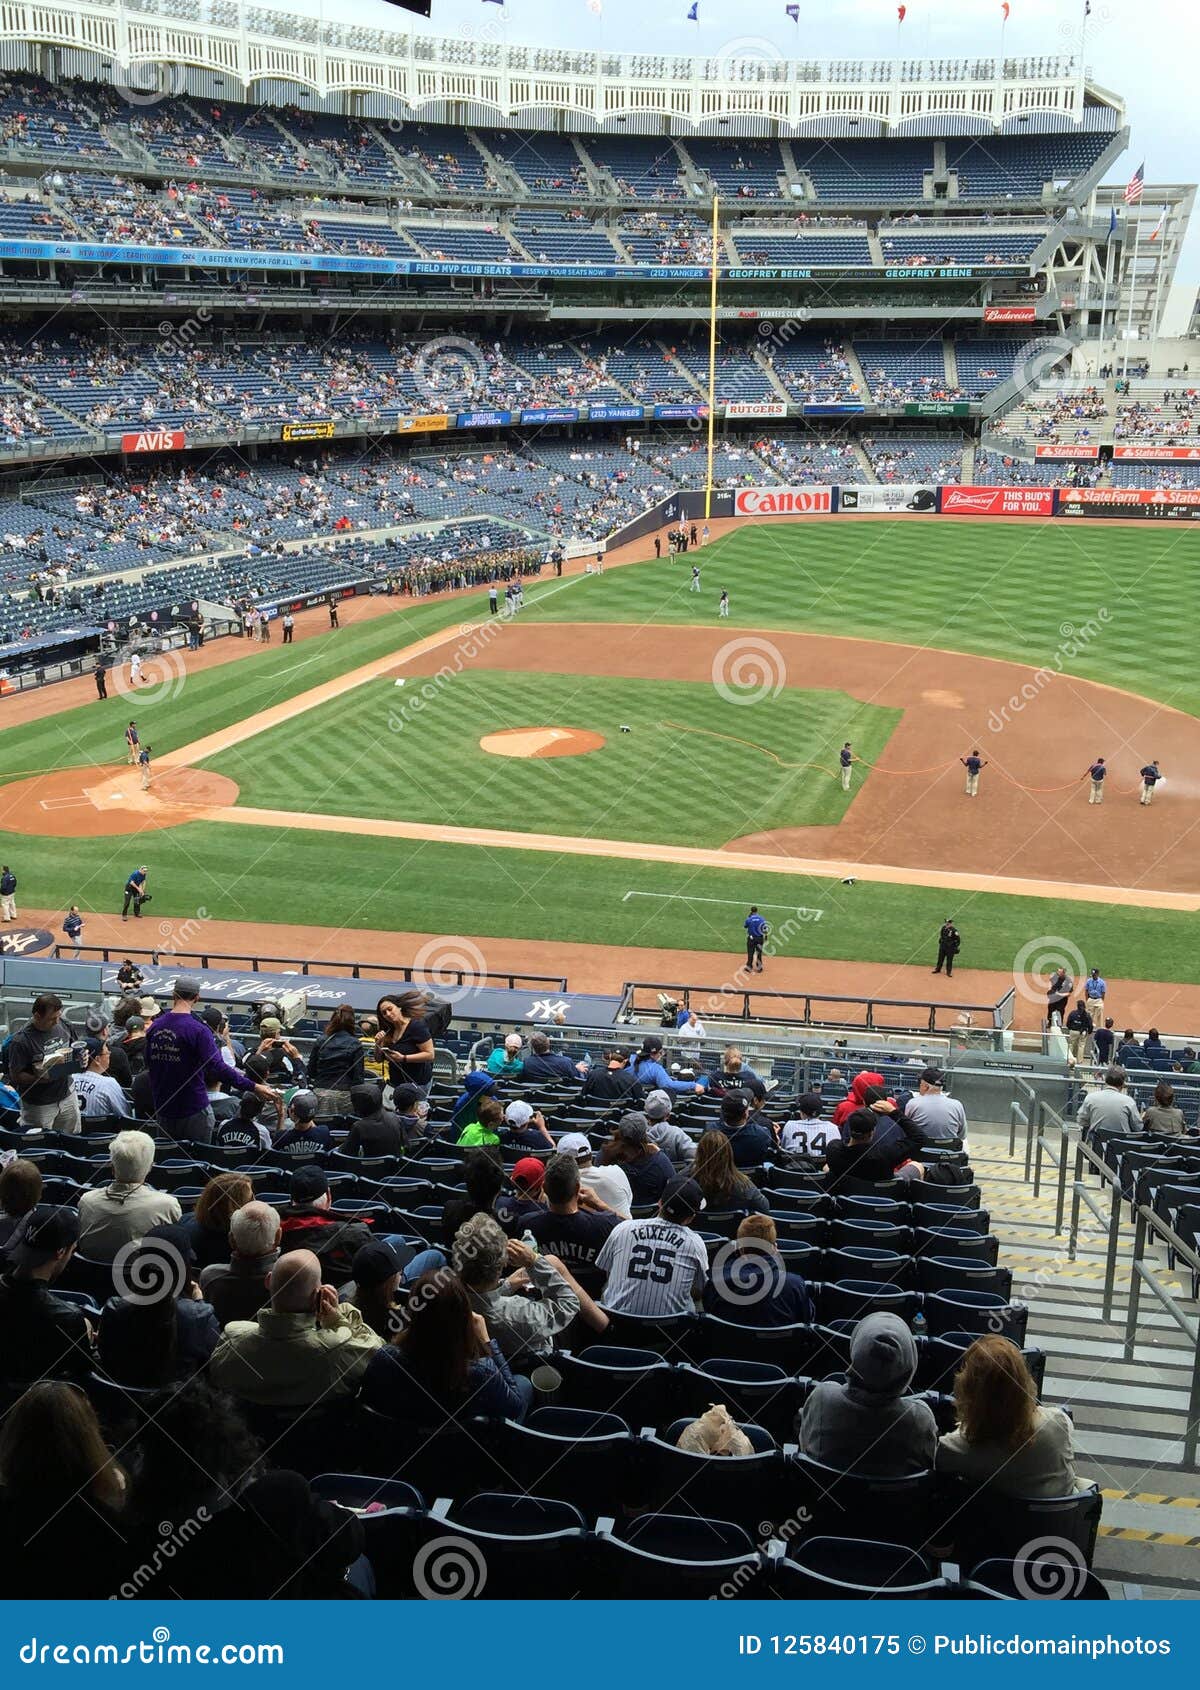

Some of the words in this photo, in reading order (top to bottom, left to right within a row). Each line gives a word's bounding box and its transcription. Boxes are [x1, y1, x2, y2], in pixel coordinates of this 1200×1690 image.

[416, 264, 440, 272] FIELD
[441, 265, 460, 273] MVP
[461, 265, 482, 274] CLUB
[483, 266, 512, 275] SEATS
[550, 268, 567, 276] YOUR
[650, 269, 668, 278] (212)
[729, 270, 777, 278] GEOFFREY
[780, 270, 811, 278] BEENE
[885, 269, 936, 278] GEOFFREY
[939, 269, 972, 277] BEENE
[985, 309, 1035, 320] Budweiser
[590, 410, 607, 419] (212)
[608, 409, 640, 418] YANKEES
[729, 405, 783, 413] RUTGERS
[135, 433, 174, 452] AVIS
[951, 494, 993, 505] Budweiser
[1003, 492, 1023, 501] THIS
[1024, 492, 1050, 501] BUD'S
[736, 490, 830, 515] Canon
[1002, 501, 1019, 511] FOR
[1021, 502, 1041, 511] YOU.
[226, 977, 346, 1001] Yankees
[792, 1131, 827, 1155] 34
[630, 1227, 684, 1250] TEIXEIRA
[540, 1240, 597, 1262] MANTLE
[627, 1244, 677, 1285] 25
